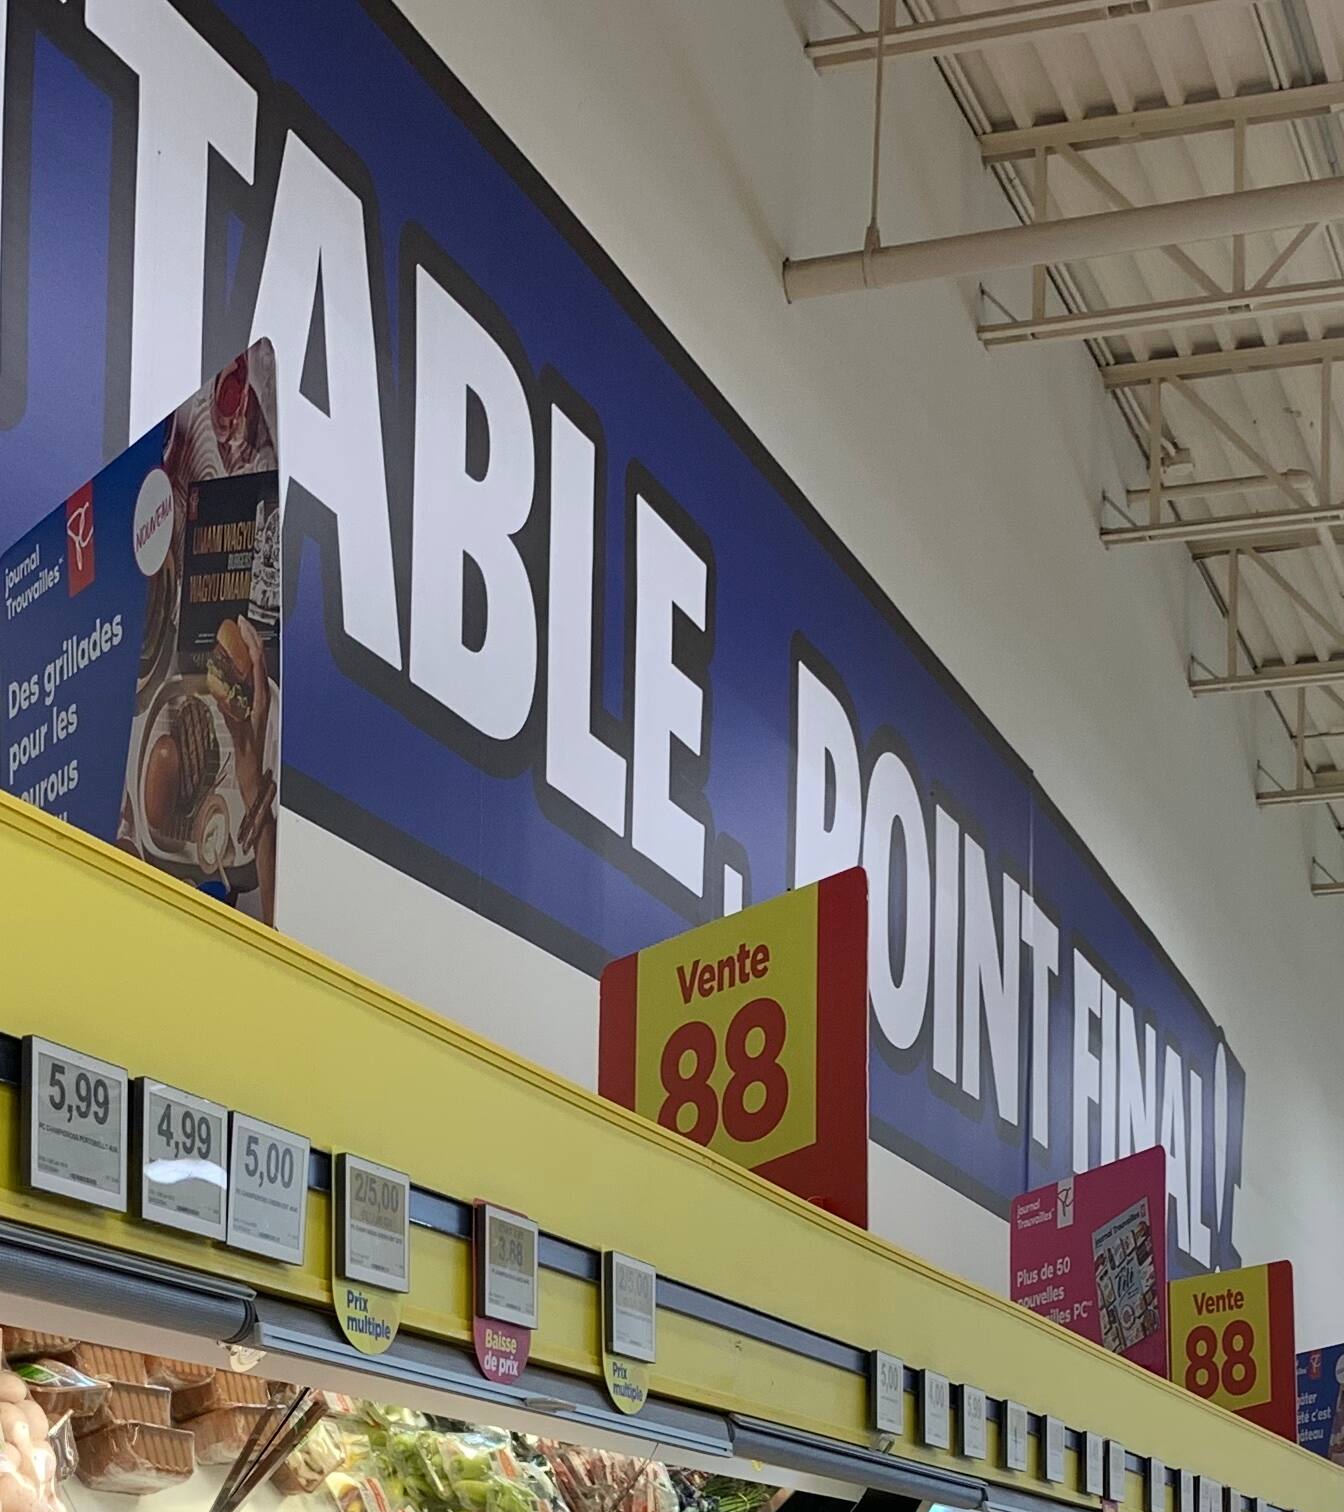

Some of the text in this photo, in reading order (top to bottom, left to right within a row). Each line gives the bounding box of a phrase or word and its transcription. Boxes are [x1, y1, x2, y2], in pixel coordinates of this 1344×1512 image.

[135, 497, 173, 552] NOUVEAU
[8, 614, 123, 719] Des grillades
[8, 703, 78, 785] pour les
[16, 759, 78, 808] urous
[675, 942, 770, 1005] Vente
[794, 659, 1059, 1149] POINT
[1073, 947, 1228, 1273] FINAL!
[49, 1063, 109, 1125] 5,99
[657, 997, 789, 1147] 88
[157, 1103, 212, 1159] 4,99
[244, 1135, 294, 1188] 5,00
[355, 1172, 399, 1213] 2/5,00
[1017, 1256, 1071, 1287] Plus de 50
[346, 1290, 369, 1313] Prix
[346, 1314, 391, 1340] multiple
[1193, 1288, 1244, 1316] Vente
[484, 1351, 519, 1377] de prix
[485, 1328, 517, 1353] Baisse
[1185, 1319, 1257, 1400] 88
[612, 1361, 627, 1379] Prix
[612, 1382, 643, 1402] multiple
